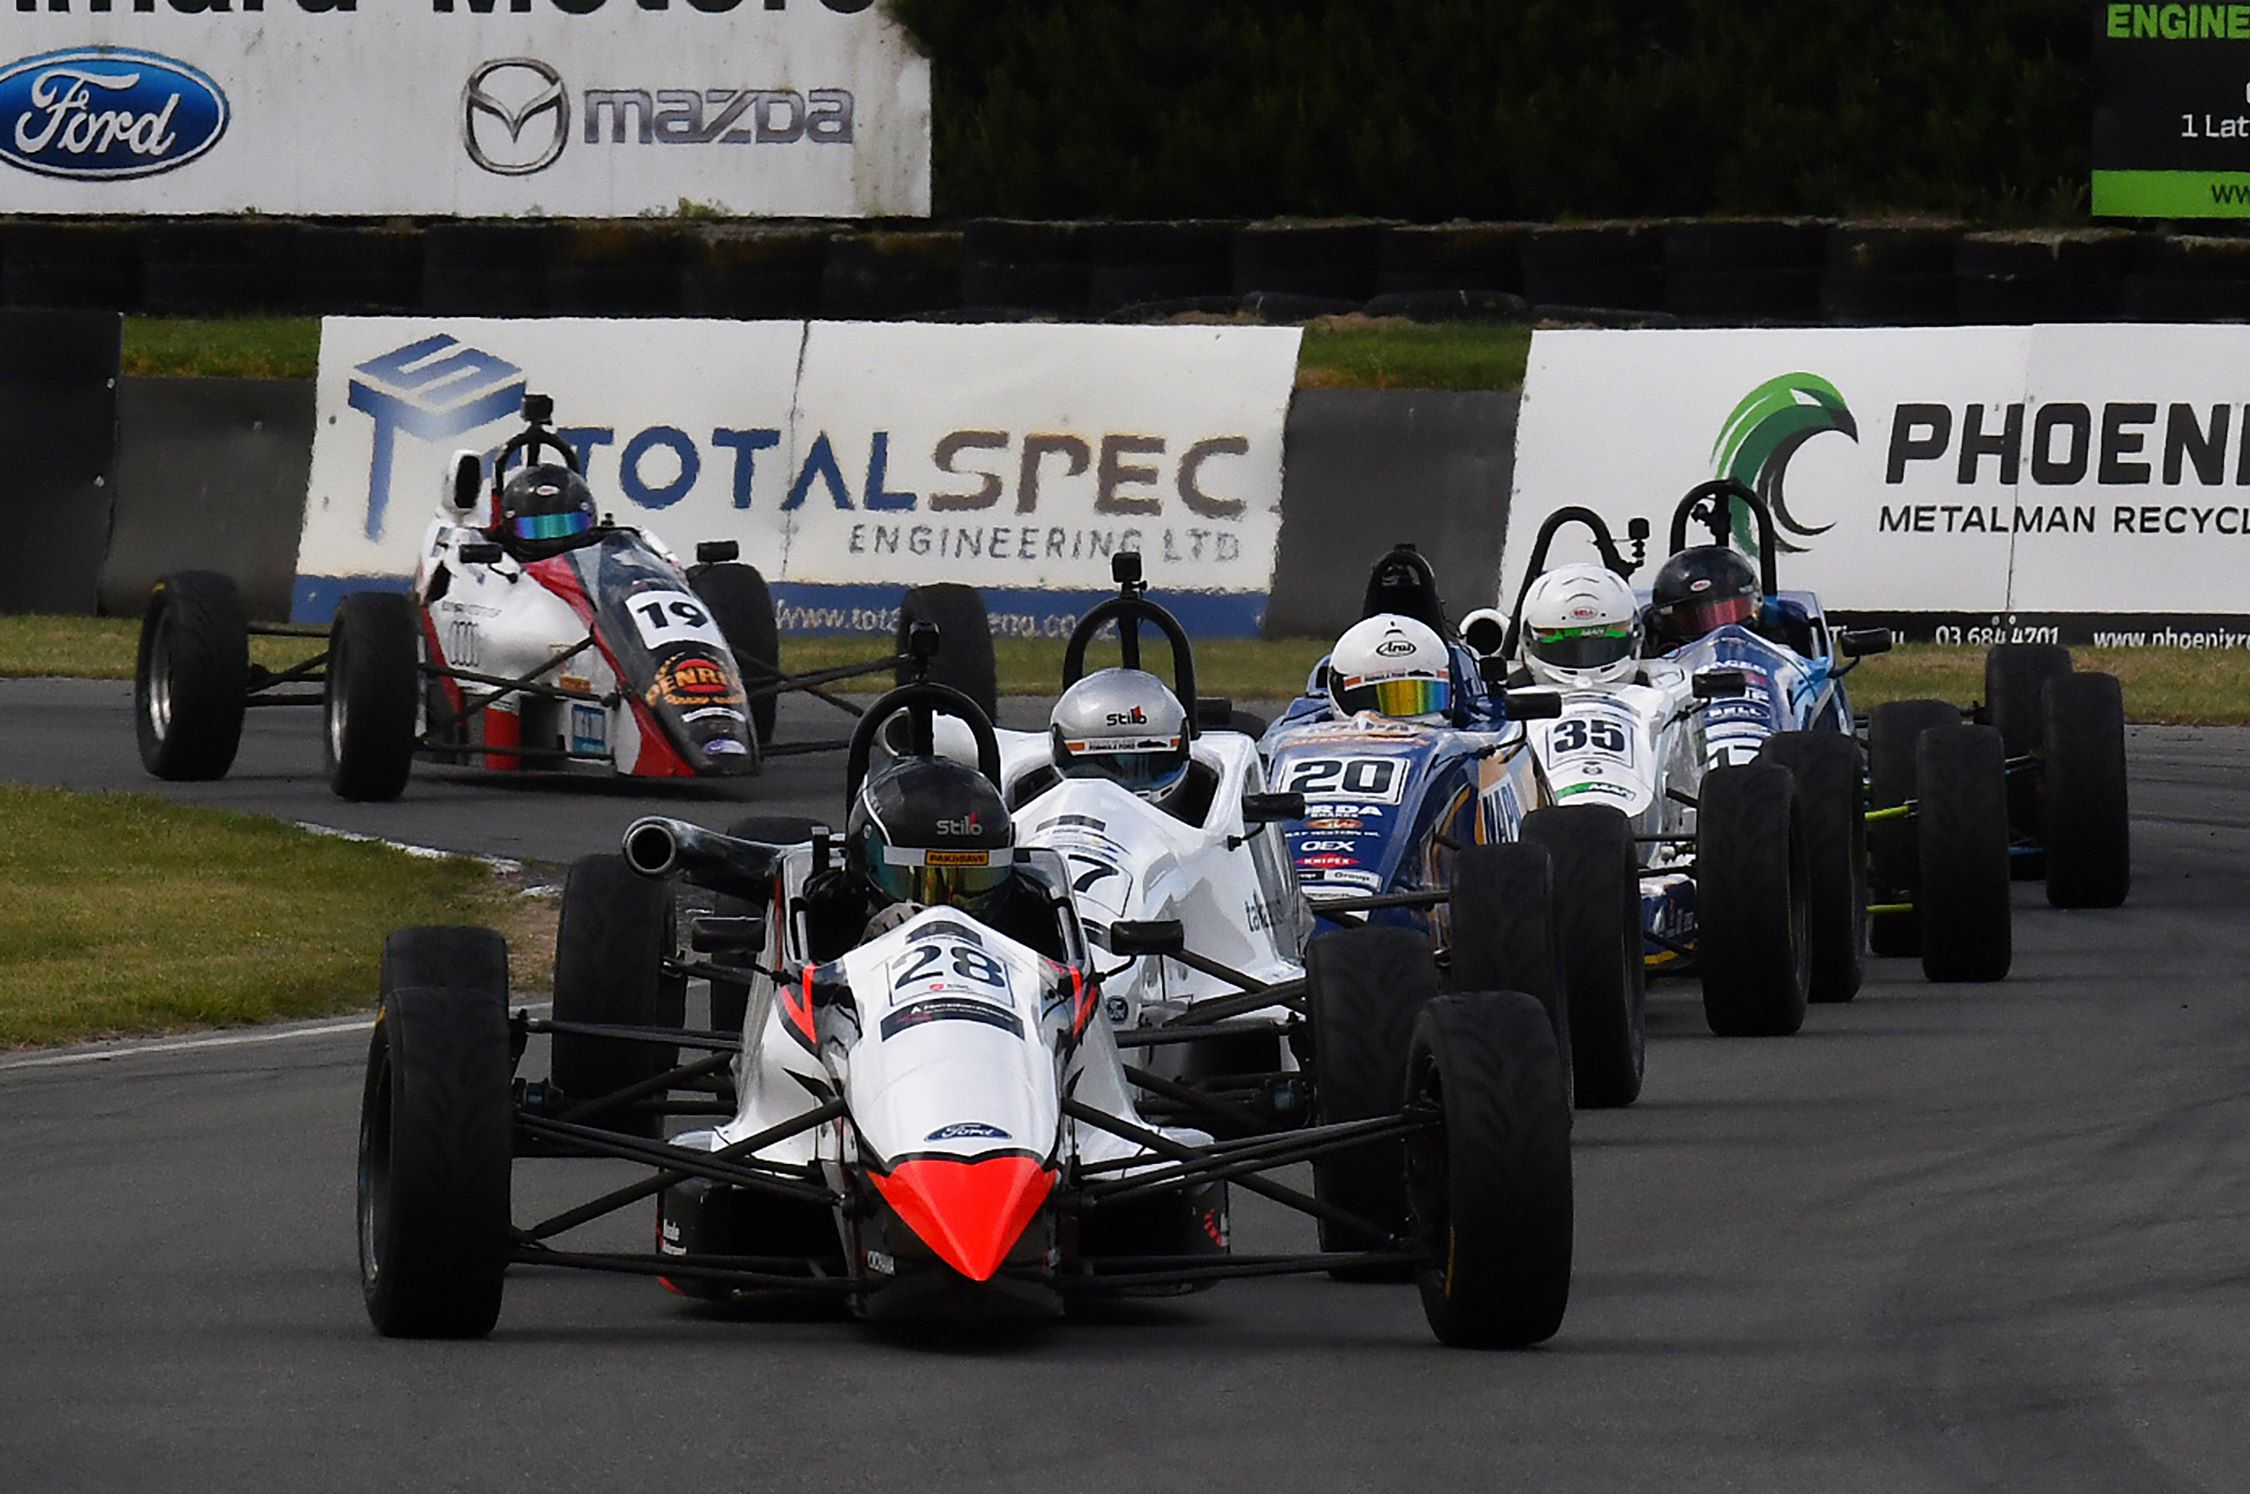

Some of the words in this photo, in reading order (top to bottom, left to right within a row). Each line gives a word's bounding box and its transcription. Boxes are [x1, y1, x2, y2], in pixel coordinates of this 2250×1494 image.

[2107, 4, 2250, 39] ENGINE
[15, 69, 180, 155] Ford
[2181, 114, 2198, 137] 1
[1879, 506, 2095, 532] METALMAN
[848, 523, 1142, 560] ENGINEERING
[1162, 529, 1240, 562] LTD
[637, 601, 709, 628] 19
[1554, 719, 1625, 752] 35
[1289, 759, 1396, 794] 20
[936, 811, 983, 835] Stilo
[1301, 841, 1355, 852] OEX
[892, 945, 1006, 989] 28
[940, 1124, 994, 1139] Ford
